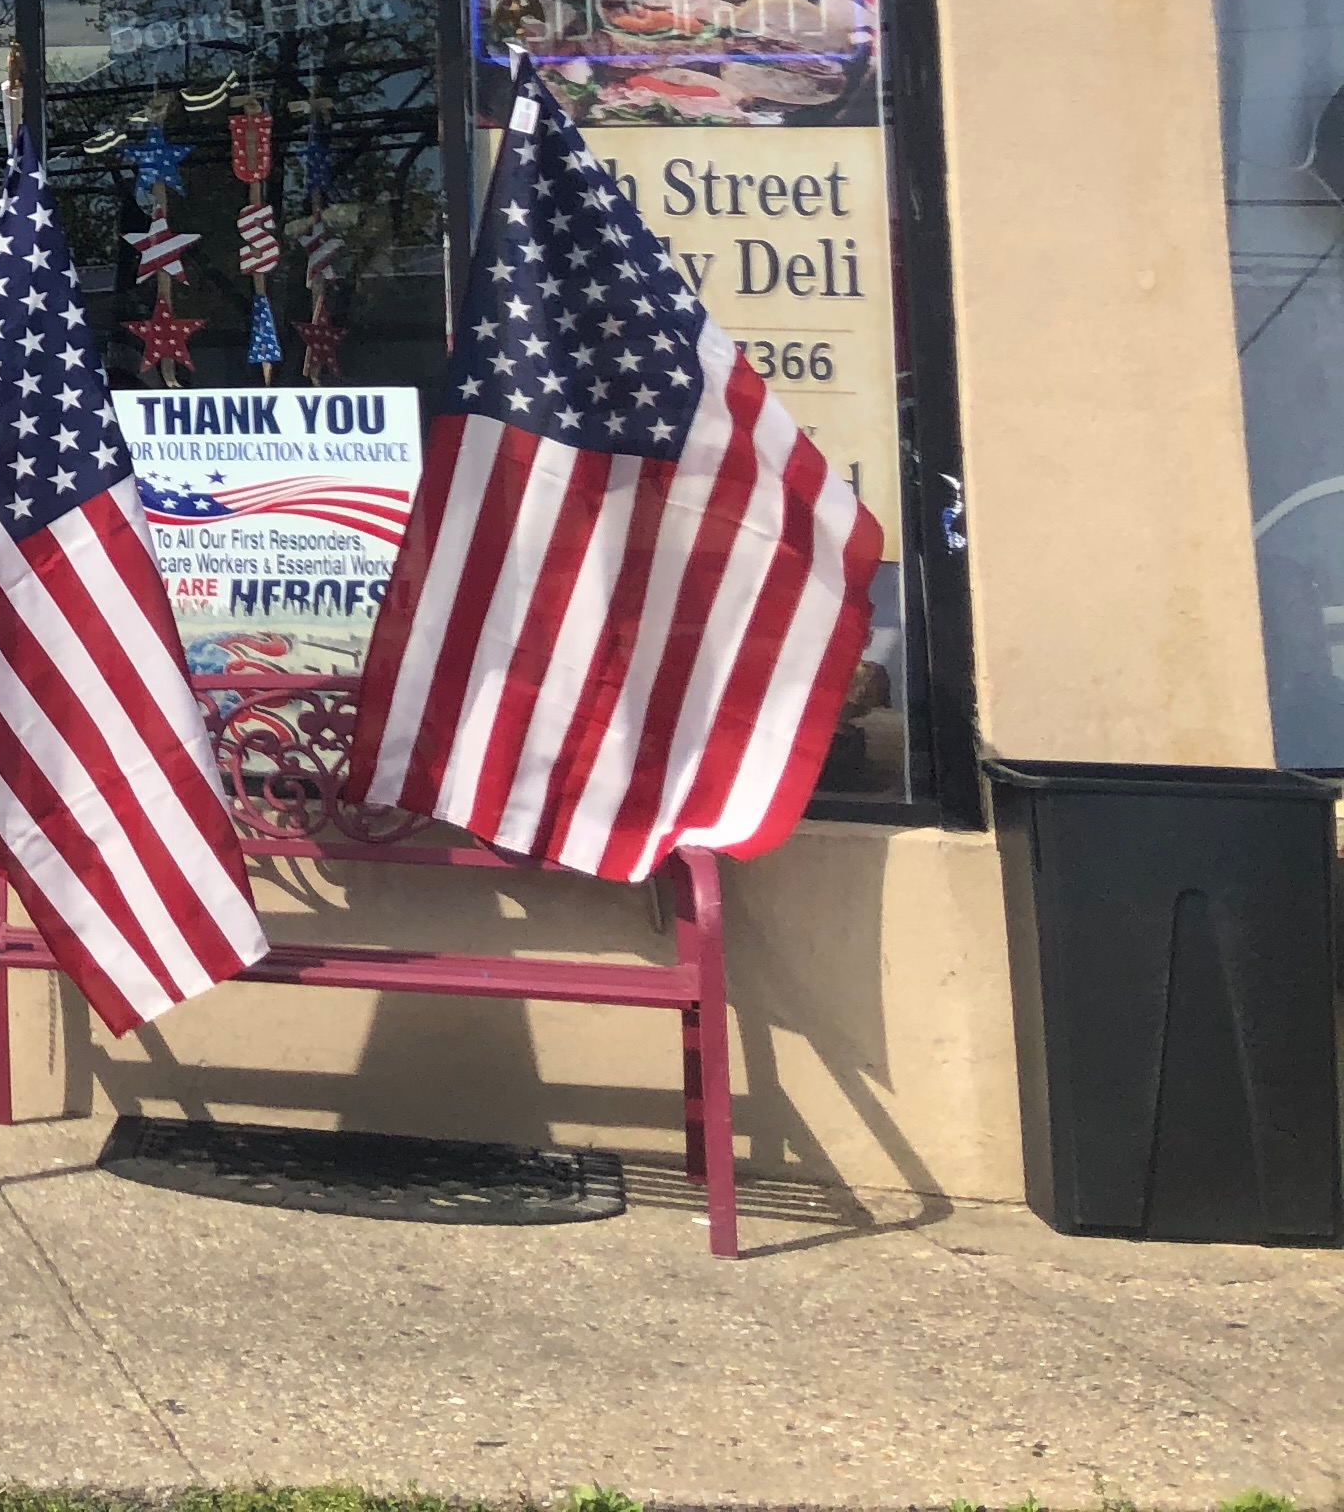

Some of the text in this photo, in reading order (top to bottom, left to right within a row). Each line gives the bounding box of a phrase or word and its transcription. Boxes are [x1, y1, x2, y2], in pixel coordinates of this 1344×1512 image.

[664, 158, 849, 217] Street
[734, 238, 866, 298] Deli
[137, 394, 386, 436] THANK YOU
[128, 441, 154, 462] OR
[156, 441, 203, 462] YOUR
[205, 441, 304, 463] DEDICATION
[307, 442, 320, 462] &
[155, 527, 367, 554] To All Our First Responders,
[195, 553, 259, 575] Workers
[263, 557, 272, 575] &
[276, 553, 347, 577] Essential
[176, 577, 219, 597] ARE
